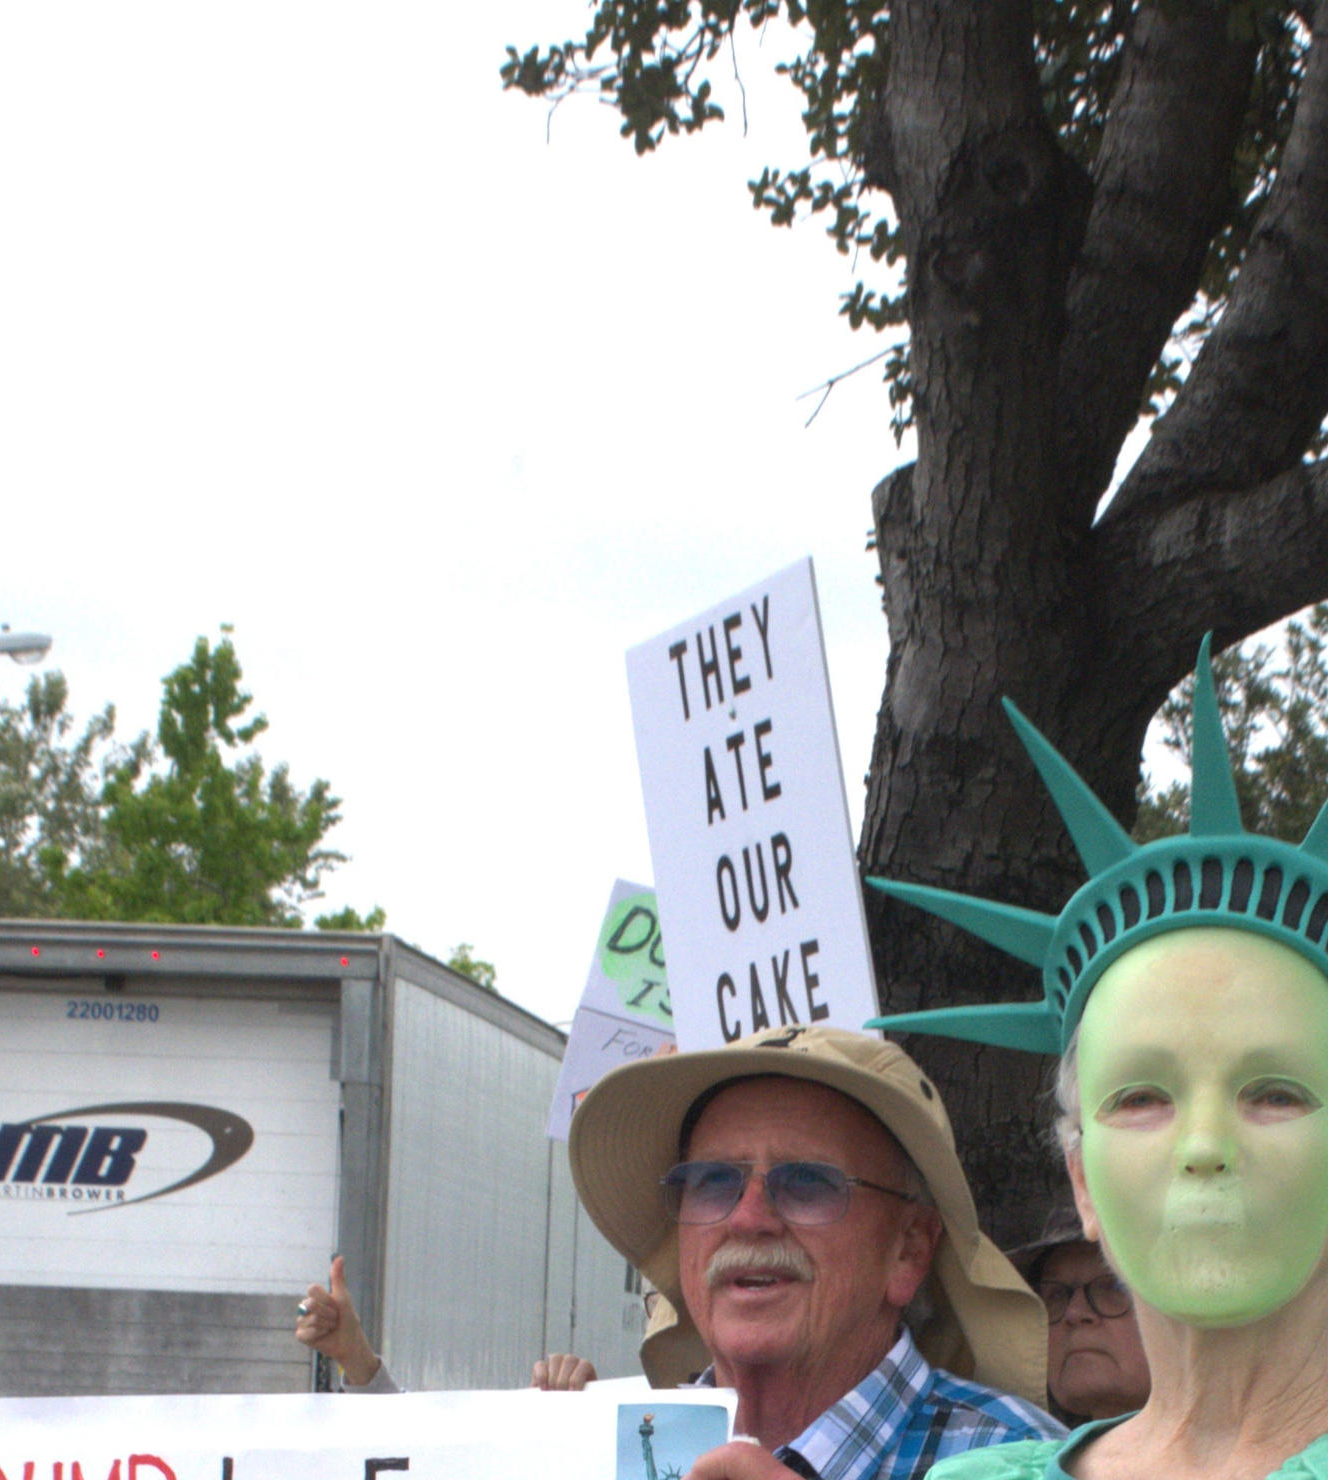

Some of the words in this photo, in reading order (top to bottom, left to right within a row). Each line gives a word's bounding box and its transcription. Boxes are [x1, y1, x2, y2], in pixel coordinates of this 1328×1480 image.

[669, 594, 773, 721] THEY
[703, 717, 782, 826] ATE
[716, 831, 800, 932] OUR
[66, 1001, 159, 1022] 22001280
[716, 938, 830, 1044] CAKE
